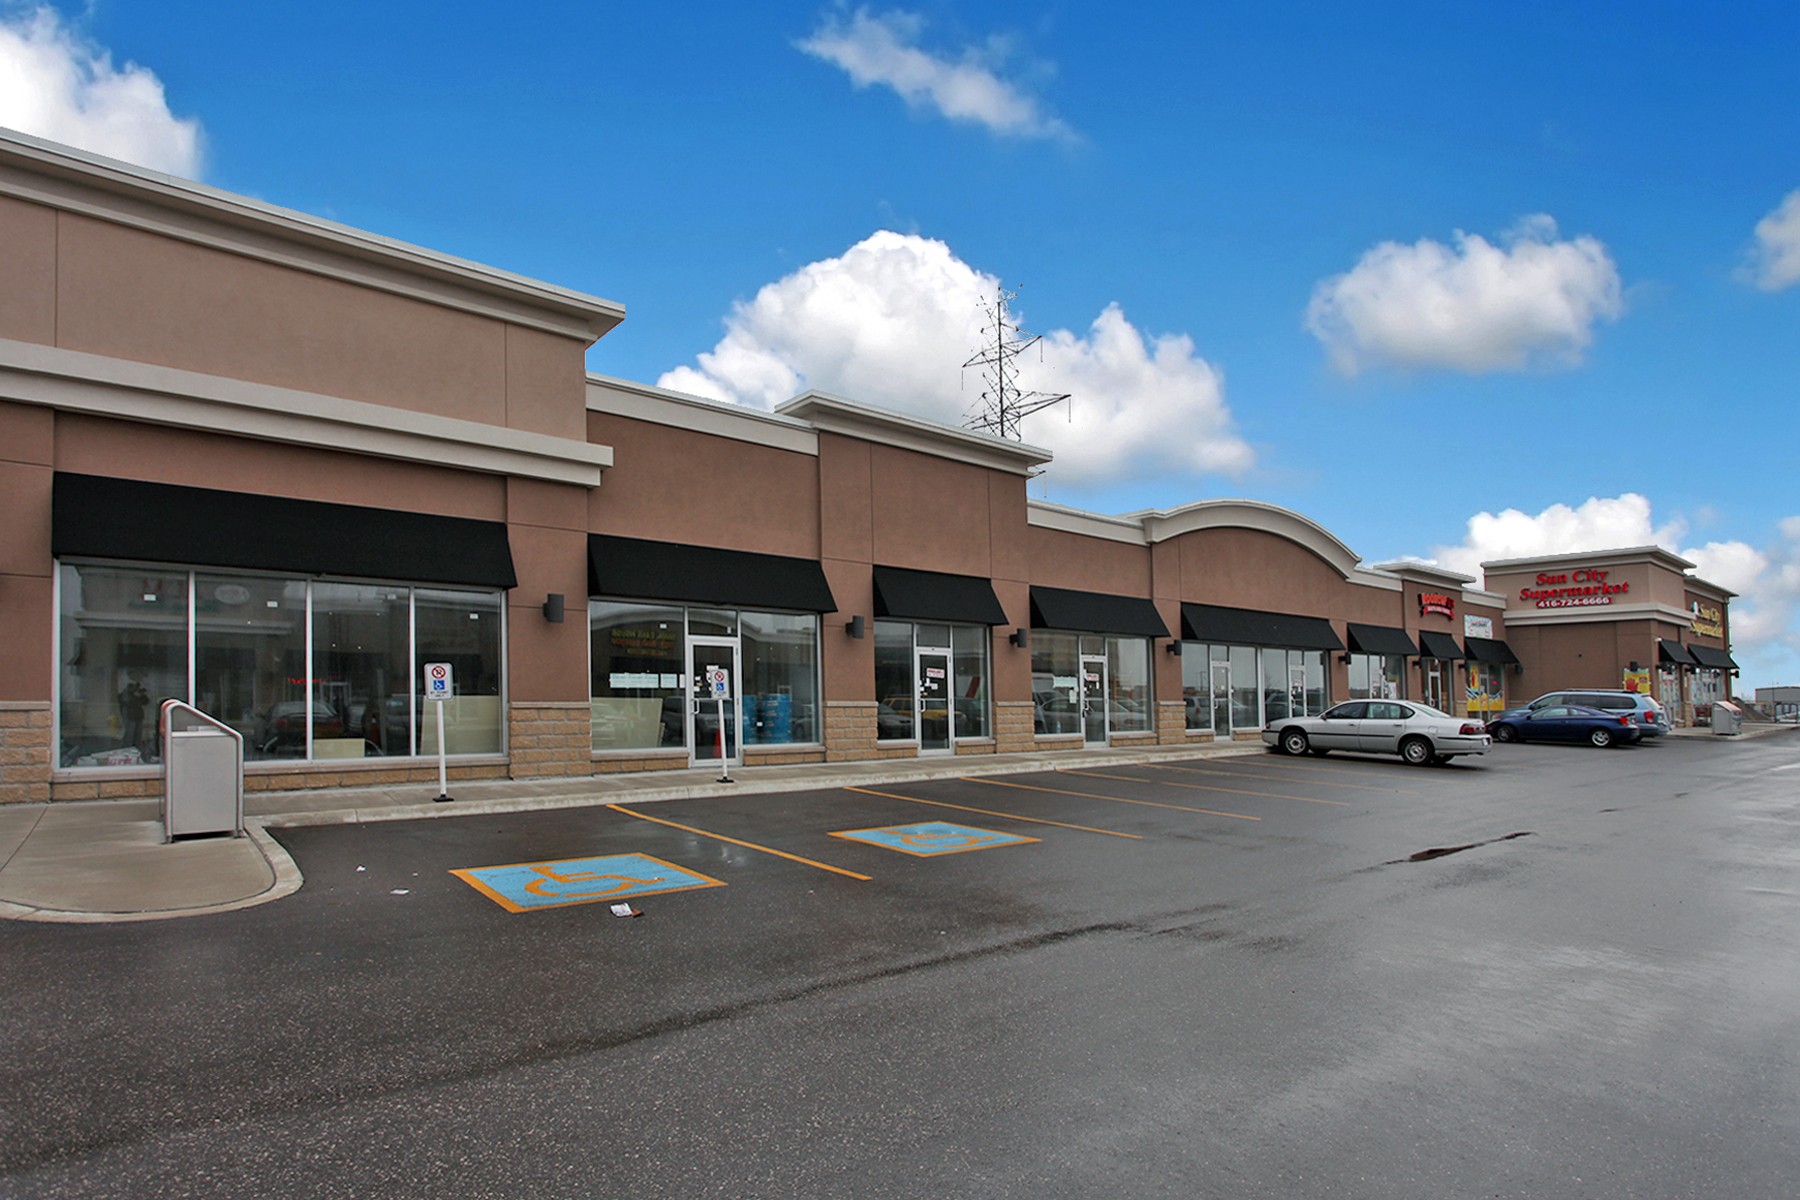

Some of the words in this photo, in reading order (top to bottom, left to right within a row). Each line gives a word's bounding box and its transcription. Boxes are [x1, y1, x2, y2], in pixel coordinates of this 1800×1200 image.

[1536, 572, 1567, 586] Sun
[1573, 568, 1609, 583] City
[1520, 581, 1629, 601] Supermarket
[1538, 597, 1609, 607] 416-724-6666
